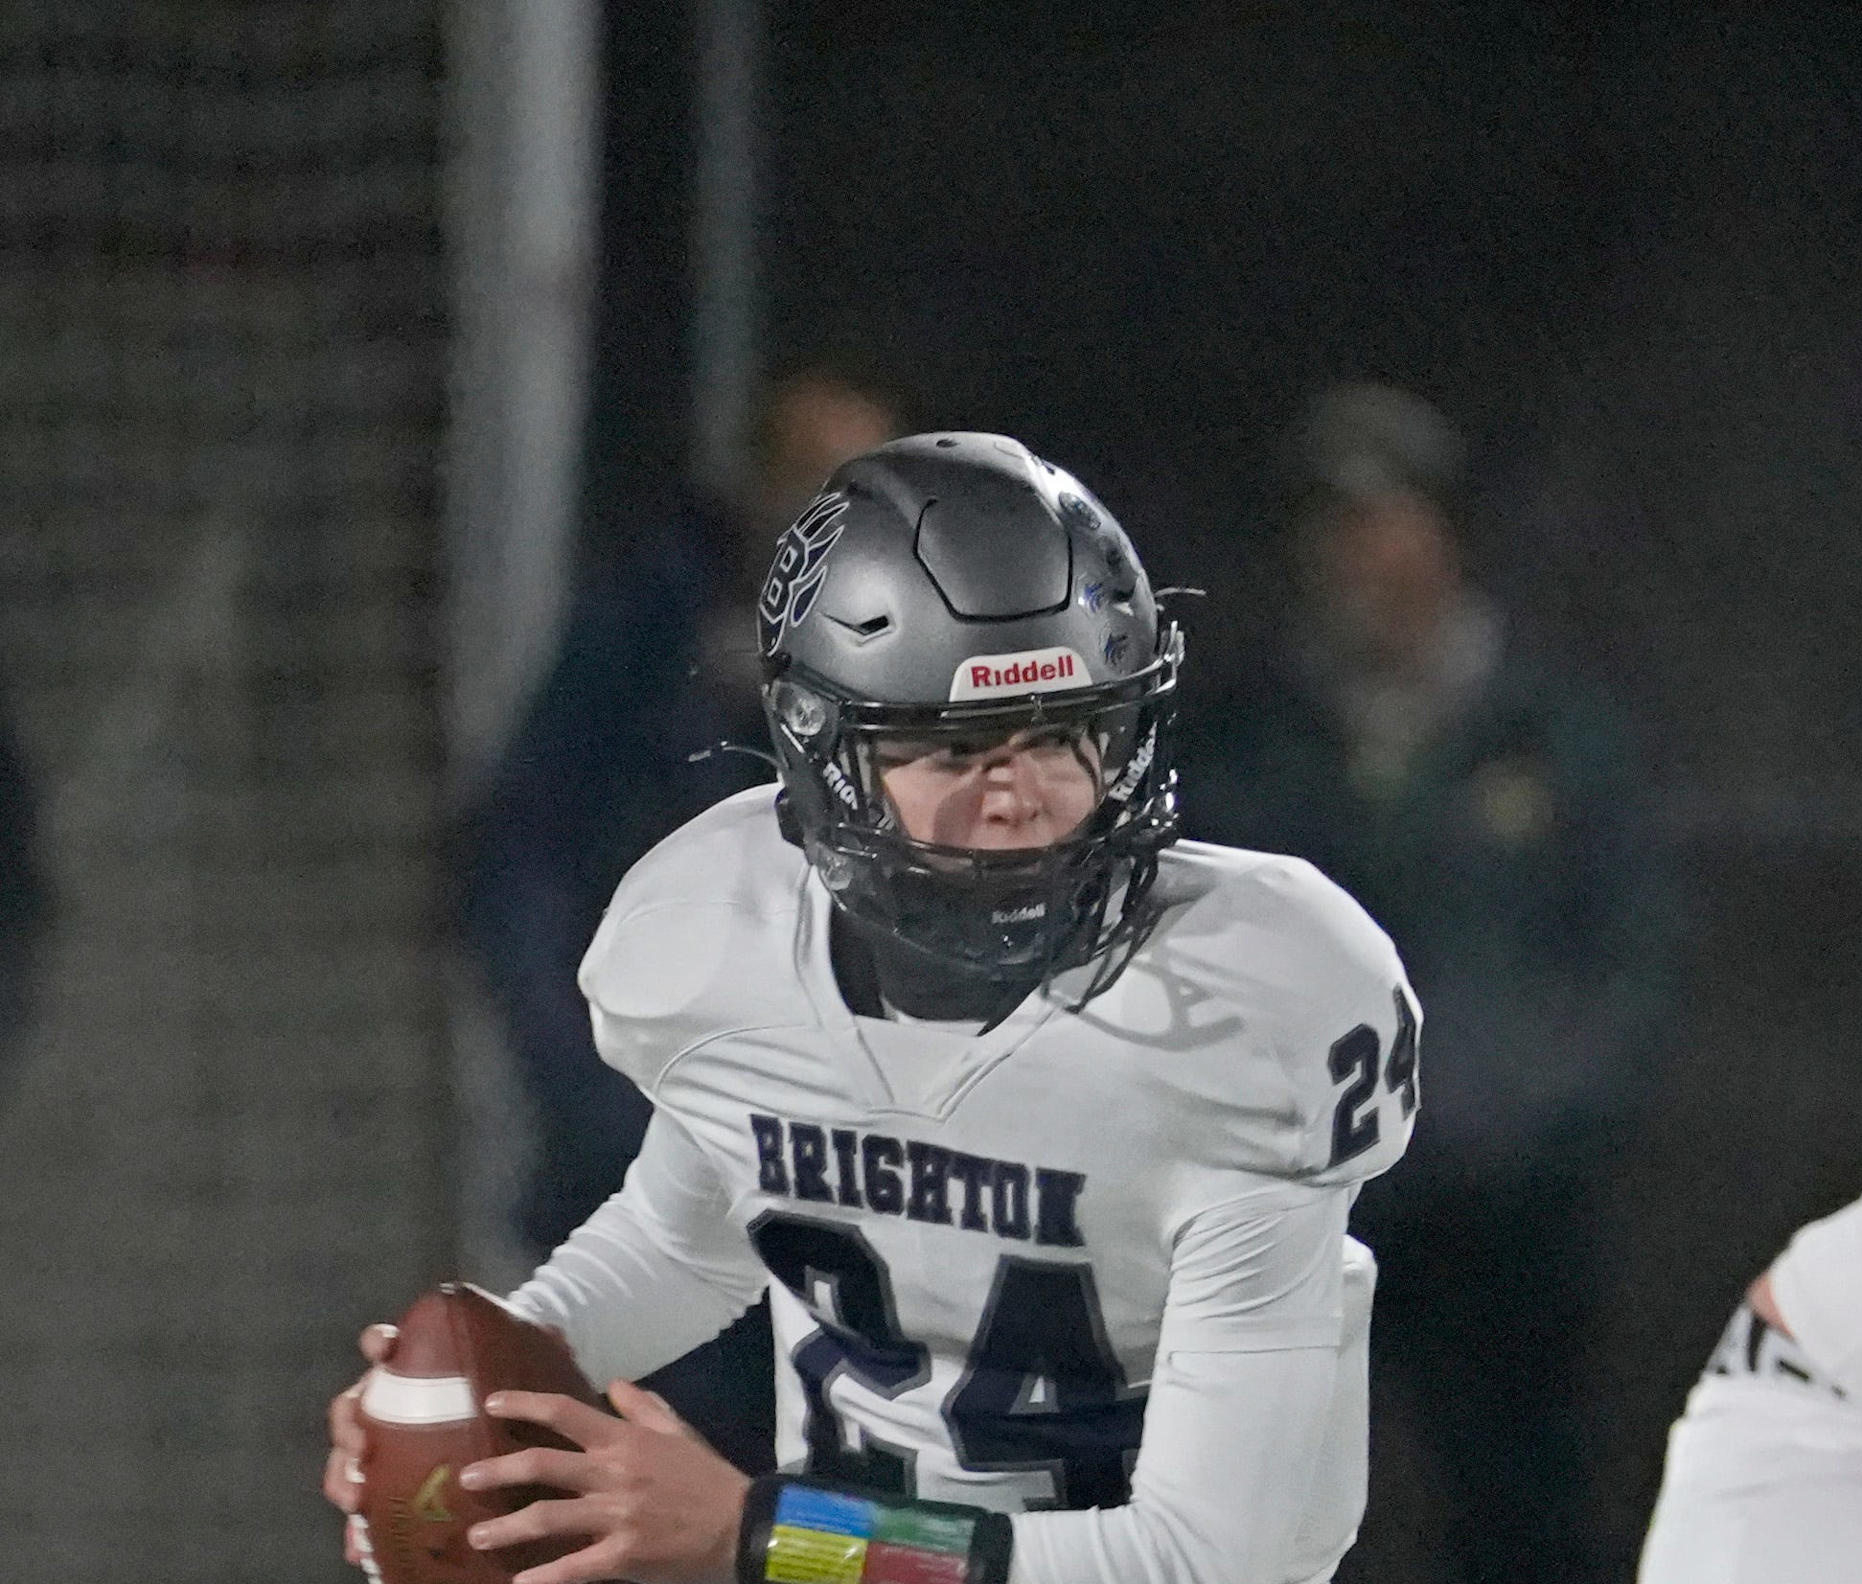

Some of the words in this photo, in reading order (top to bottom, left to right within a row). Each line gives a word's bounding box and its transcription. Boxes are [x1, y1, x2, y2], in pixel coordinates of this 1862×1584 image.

[970, 654, 1073, 688] Riddell
[750, 1113, 1087, 1247] BRIGHTON
[745, 1207, 1150, 1512] 24
